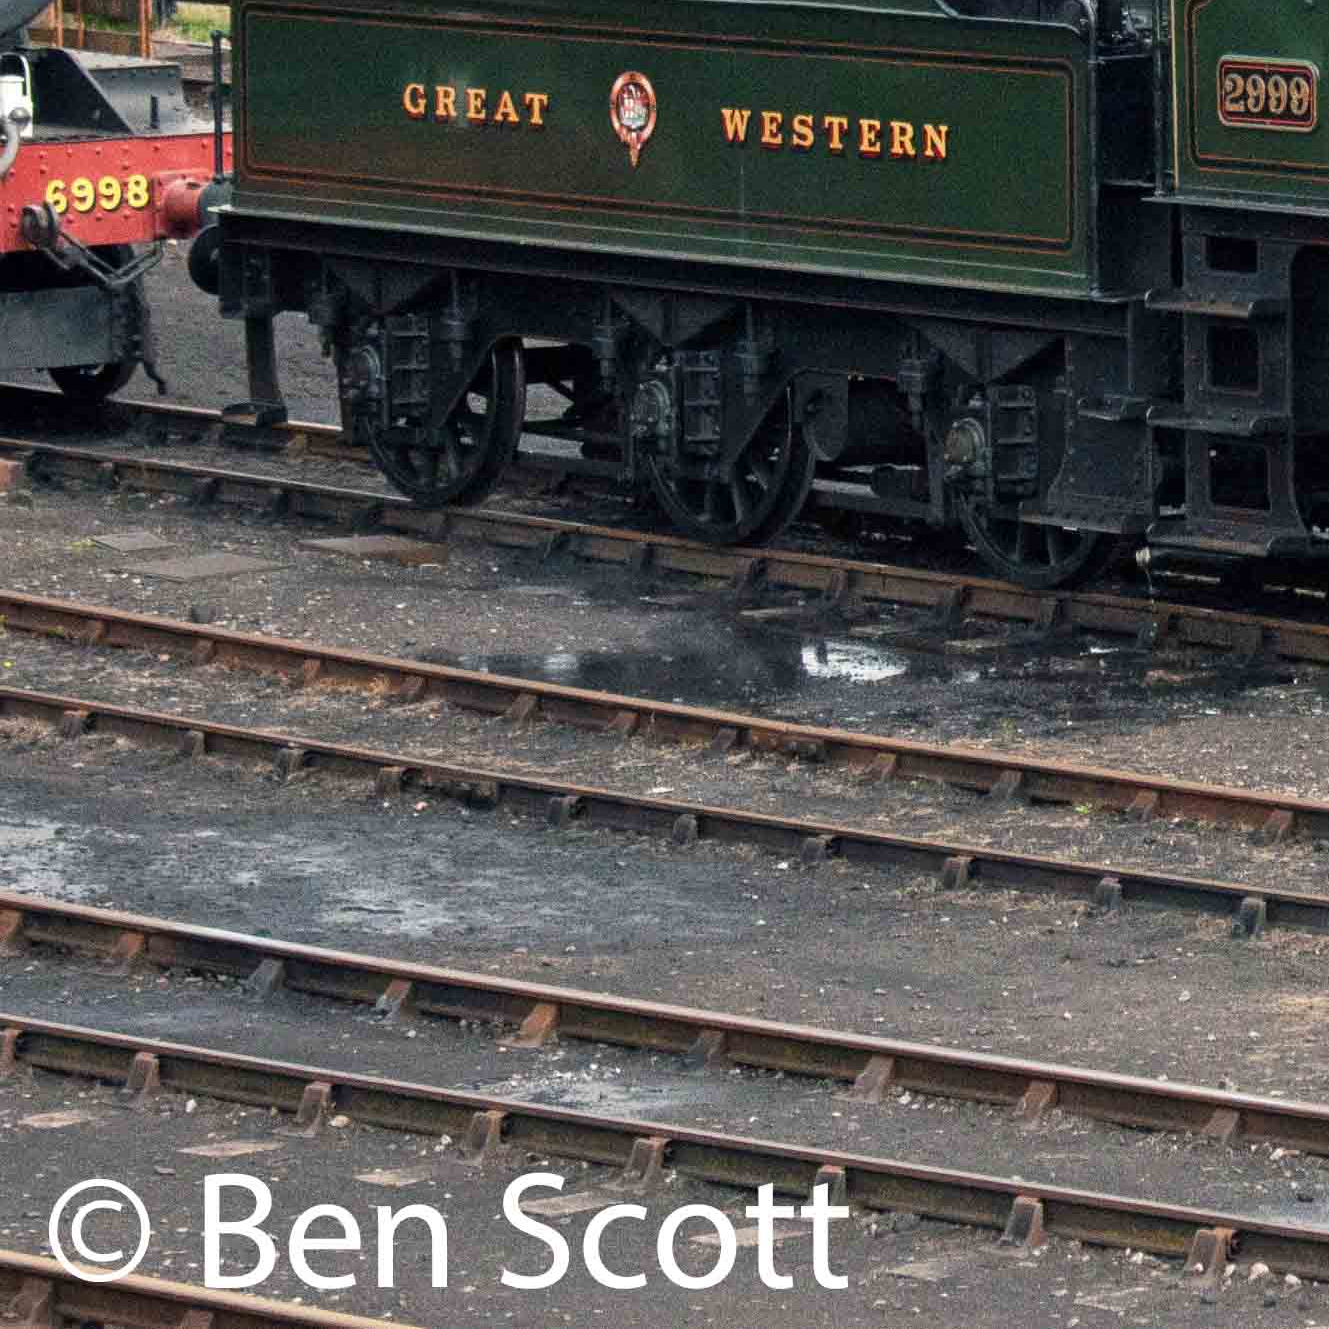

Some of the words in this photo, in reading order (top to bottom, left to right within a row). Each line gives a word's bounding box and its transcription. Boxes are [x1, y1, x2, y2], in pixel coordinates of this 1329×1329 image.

[1224, 72, 1310, 116] 2999
[402, 82, 549, 126] GREAT
[721, 107, 949, 159] WESTERN
[46, 174, 150, 214] 6998
